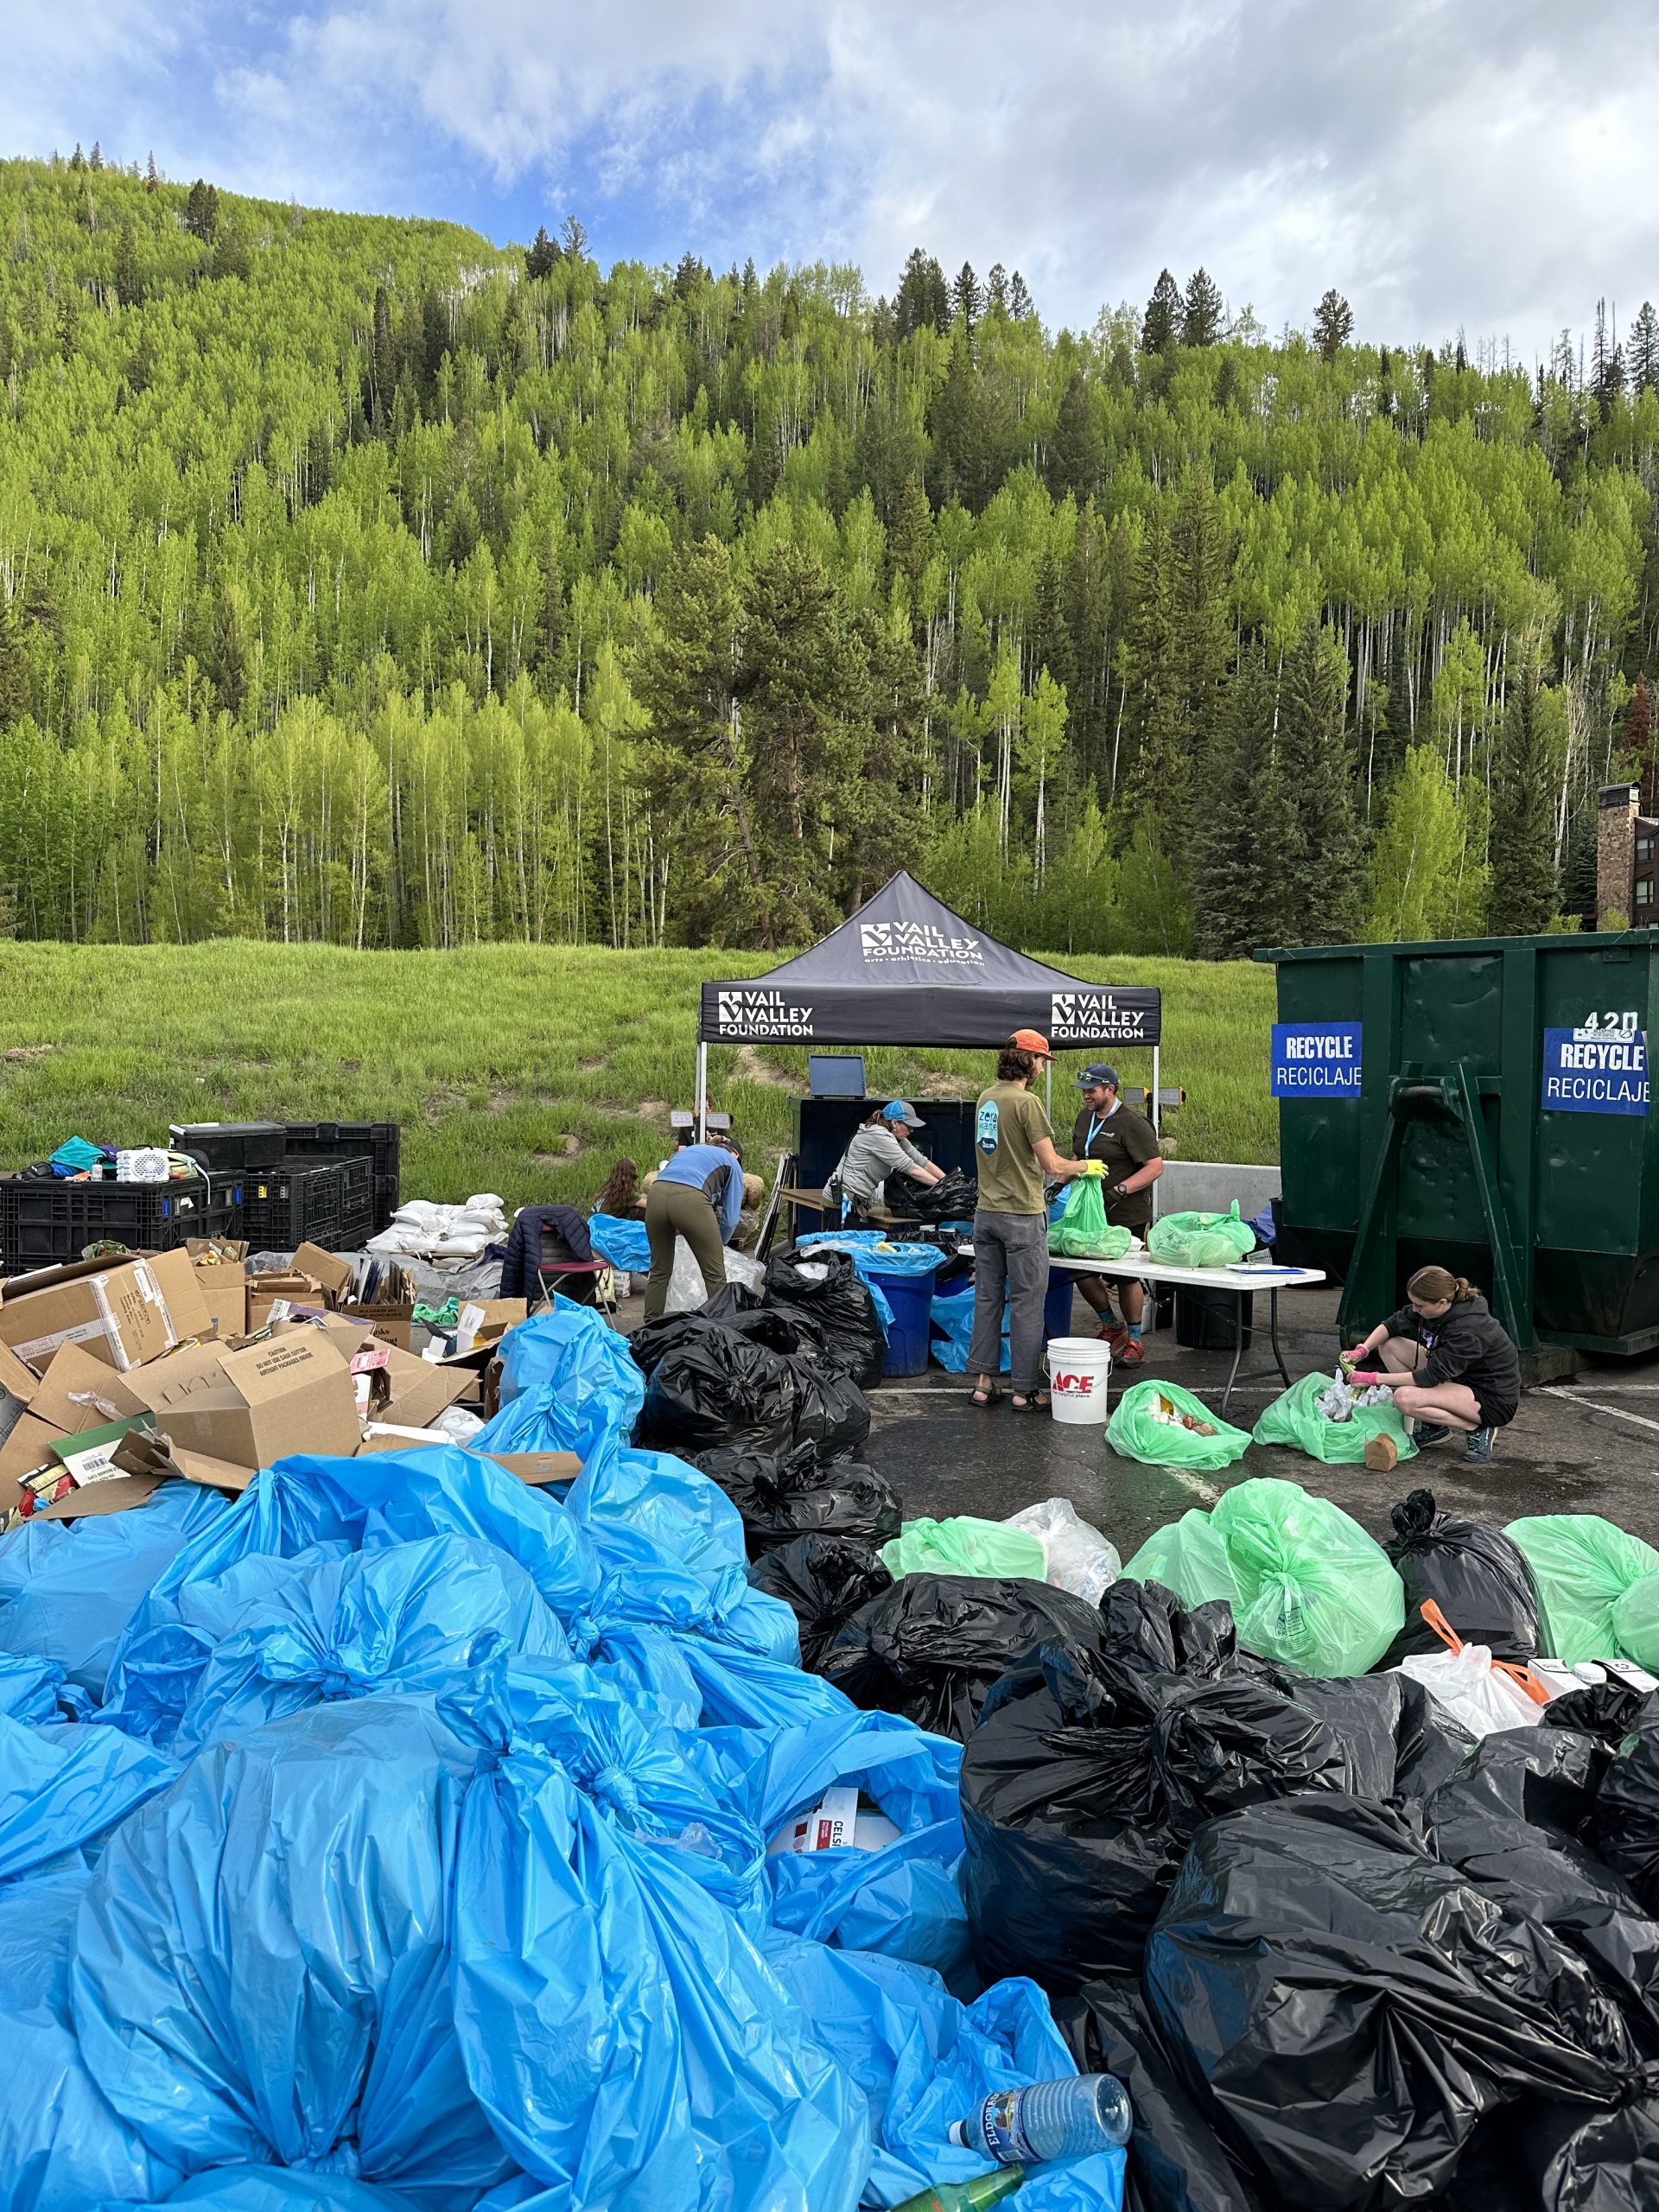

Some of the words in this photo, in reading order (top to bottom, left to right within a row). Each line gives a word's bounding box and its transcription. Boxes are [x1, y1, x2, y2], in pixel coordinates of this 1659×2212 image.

[893, 921, 944, 938] VAIL
[895, 932, 980, 950] VALLEY
[863, 944, 983, 961] FOUNDATION
[744, 991, 785, 1007] VAIL
[1077, 994, 1117, 1010] VAIL
[744, 1007, 813, 1023] VALLEY
[1077, 1010, 1145, 1027] VALLEY
[1585, 1011, 1638, 1032] 420
[719, 1024, 814, 1036] FOUNDATION
[1051, 1026, 1144, 1039] FOUNDATION
[1286, 1036, 1353, 1059] RECYCLE
[1560, 1043, 1644, 1071] RECYCLE
[1277, 1066, 1362, 1086] RECICLAJE
[1548, 1077, 1650, 1103] RECICLAJE
[268, 1347, 287, 1357] CAUTION
[290, 1346, 308, 1356] CUTTER
[278, 1357, 301, 1370] PACKAGES
[298, 1352, 314, 1361] INSIDE
[1052, 1370, 1095, 1393] ACE
[832, 1821, 843, 1847] CELSI
[985, 2093, 1001, 2145] ELDORAD
